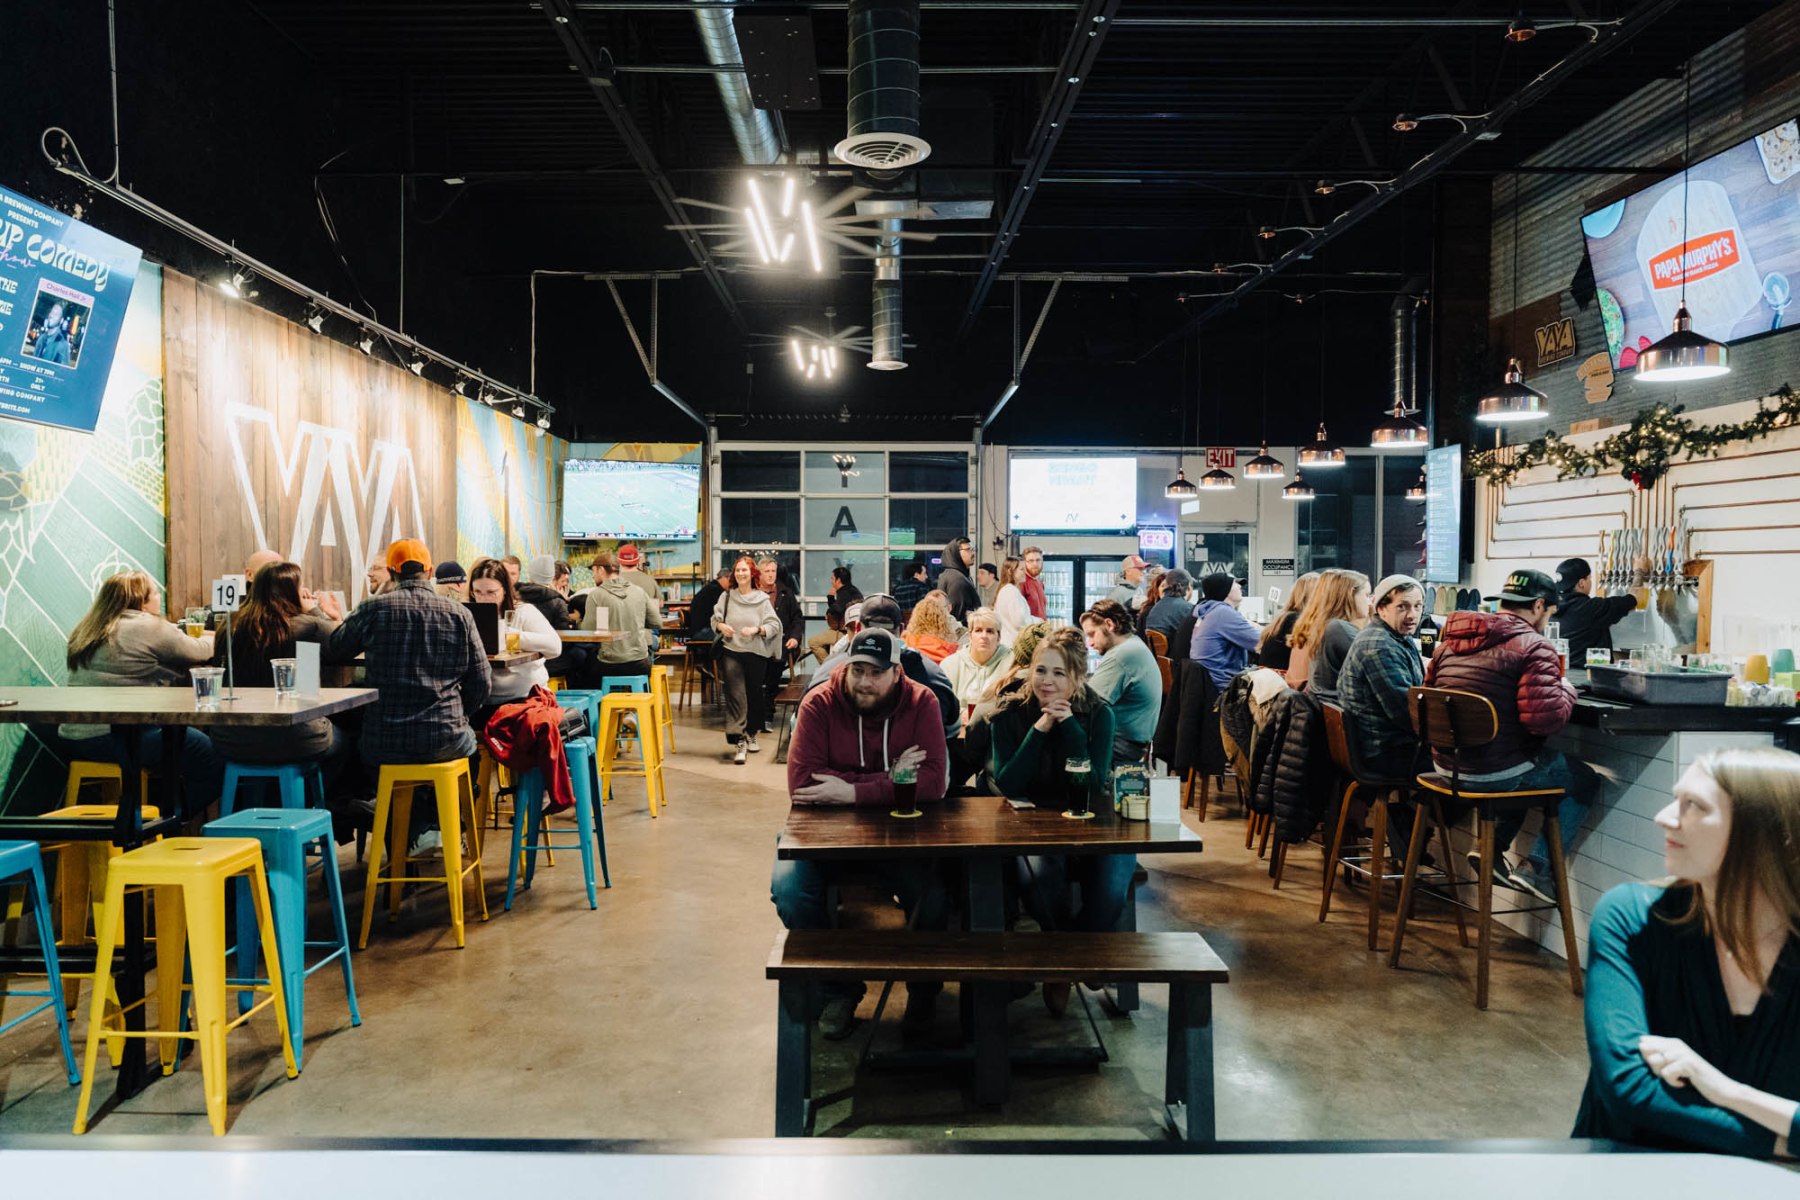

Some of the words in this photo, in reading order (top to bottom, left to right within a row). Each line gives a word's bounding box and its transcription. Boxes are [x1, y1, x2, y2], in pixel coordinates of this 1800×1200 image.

[4, 196, 34, 214] BREWING
[34, 209, 64, 227] COMPANY
[8, 210, 39, 228] PRESENTS
[27, 234, 111, 292] COMEDY
[1654, 257, 1680, 280] PAPA
[1678, 237, 1732, 272] MURPHY'S
[16, 391, 46, 403] COMPANY
[1207, 449, 1234, 467] EXIT
[1506, 575, 1529, 586] AUI
[216, 585, 235, 606] 19
